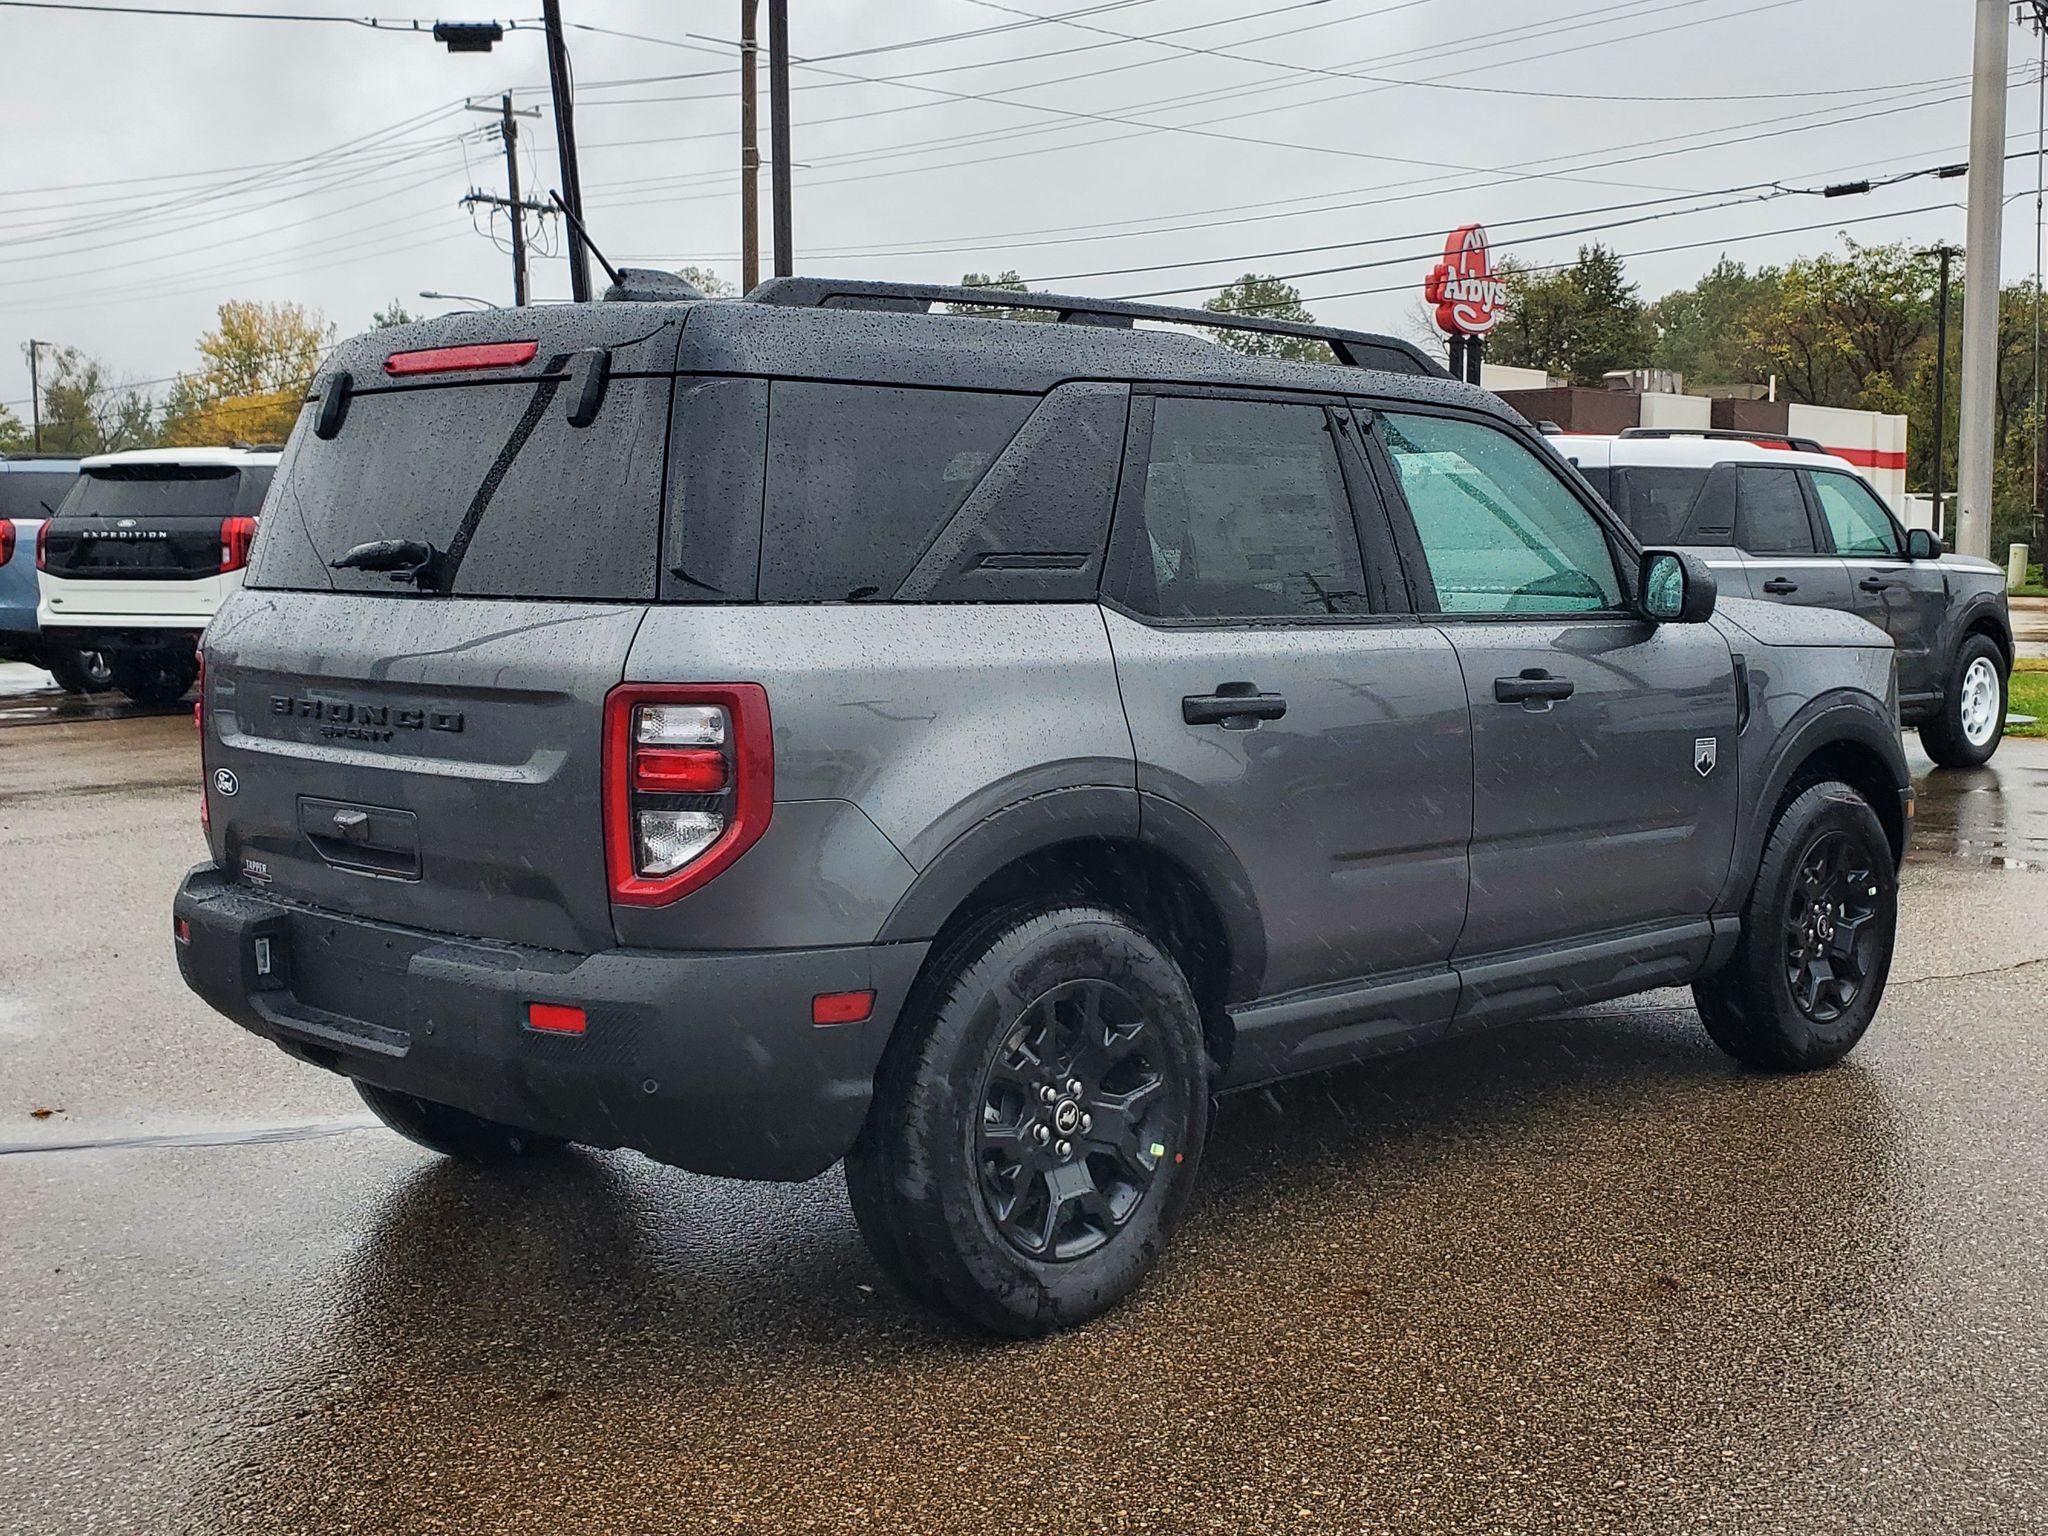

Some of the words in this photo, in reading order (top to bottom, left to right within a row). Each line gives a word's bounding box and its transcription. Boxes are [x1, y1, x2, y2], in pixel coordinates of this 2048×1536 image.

[82, 531, 167, 539] EXPEDITION
[271, 695, 464, 733] BRONCO
[319, 724, 394, 743] SPORT
[245, 859, 267, 873] TAPPER
